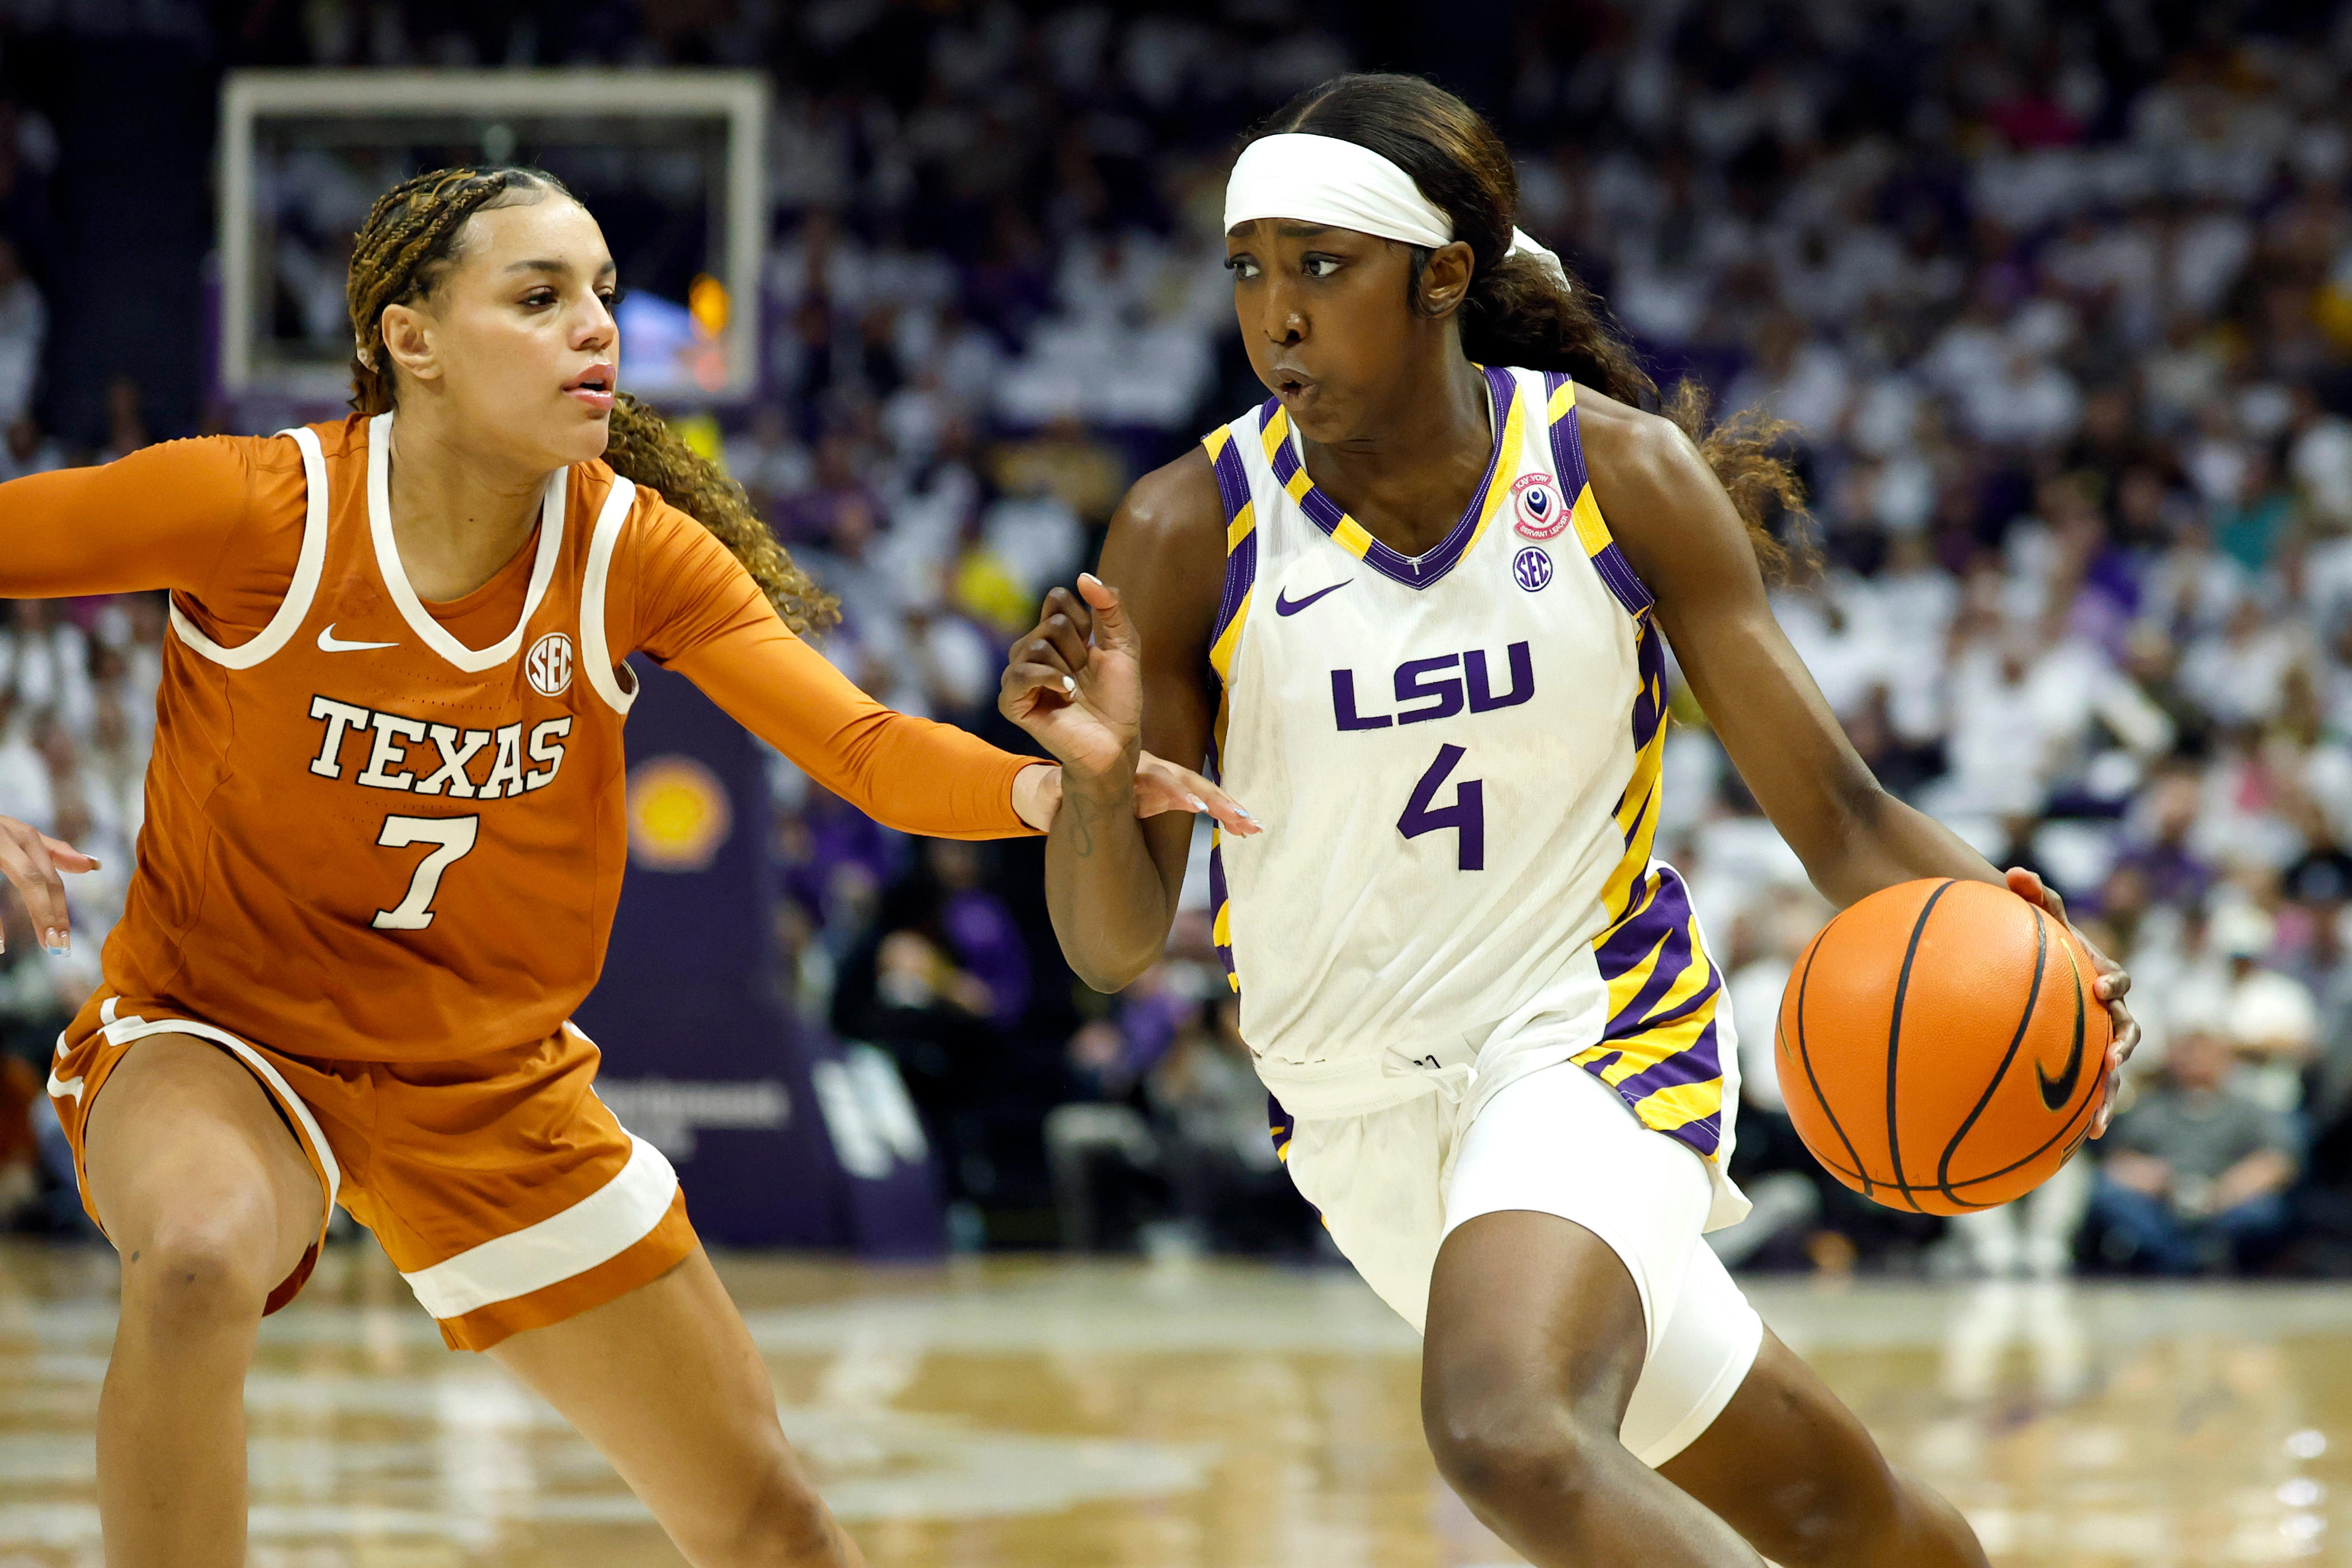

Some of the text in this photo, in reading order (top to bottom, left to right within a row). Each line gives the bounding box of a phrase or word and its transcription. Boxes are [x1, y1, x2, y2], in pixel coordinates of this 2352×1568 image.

[1515, 474, 1548, 489] KAY YOW
[1519, 514, 1569, 537] SERVANT LEADER
[1516, 551, 1549, 588] SEC
[530, 636, 573, 692] SEC
[1330, 640, 1535, 731] LSU
[308, 693, 573, 800] TEXAS
[1396, 743, 1485, 871] 4
[369, 814, 480, 931] 7
